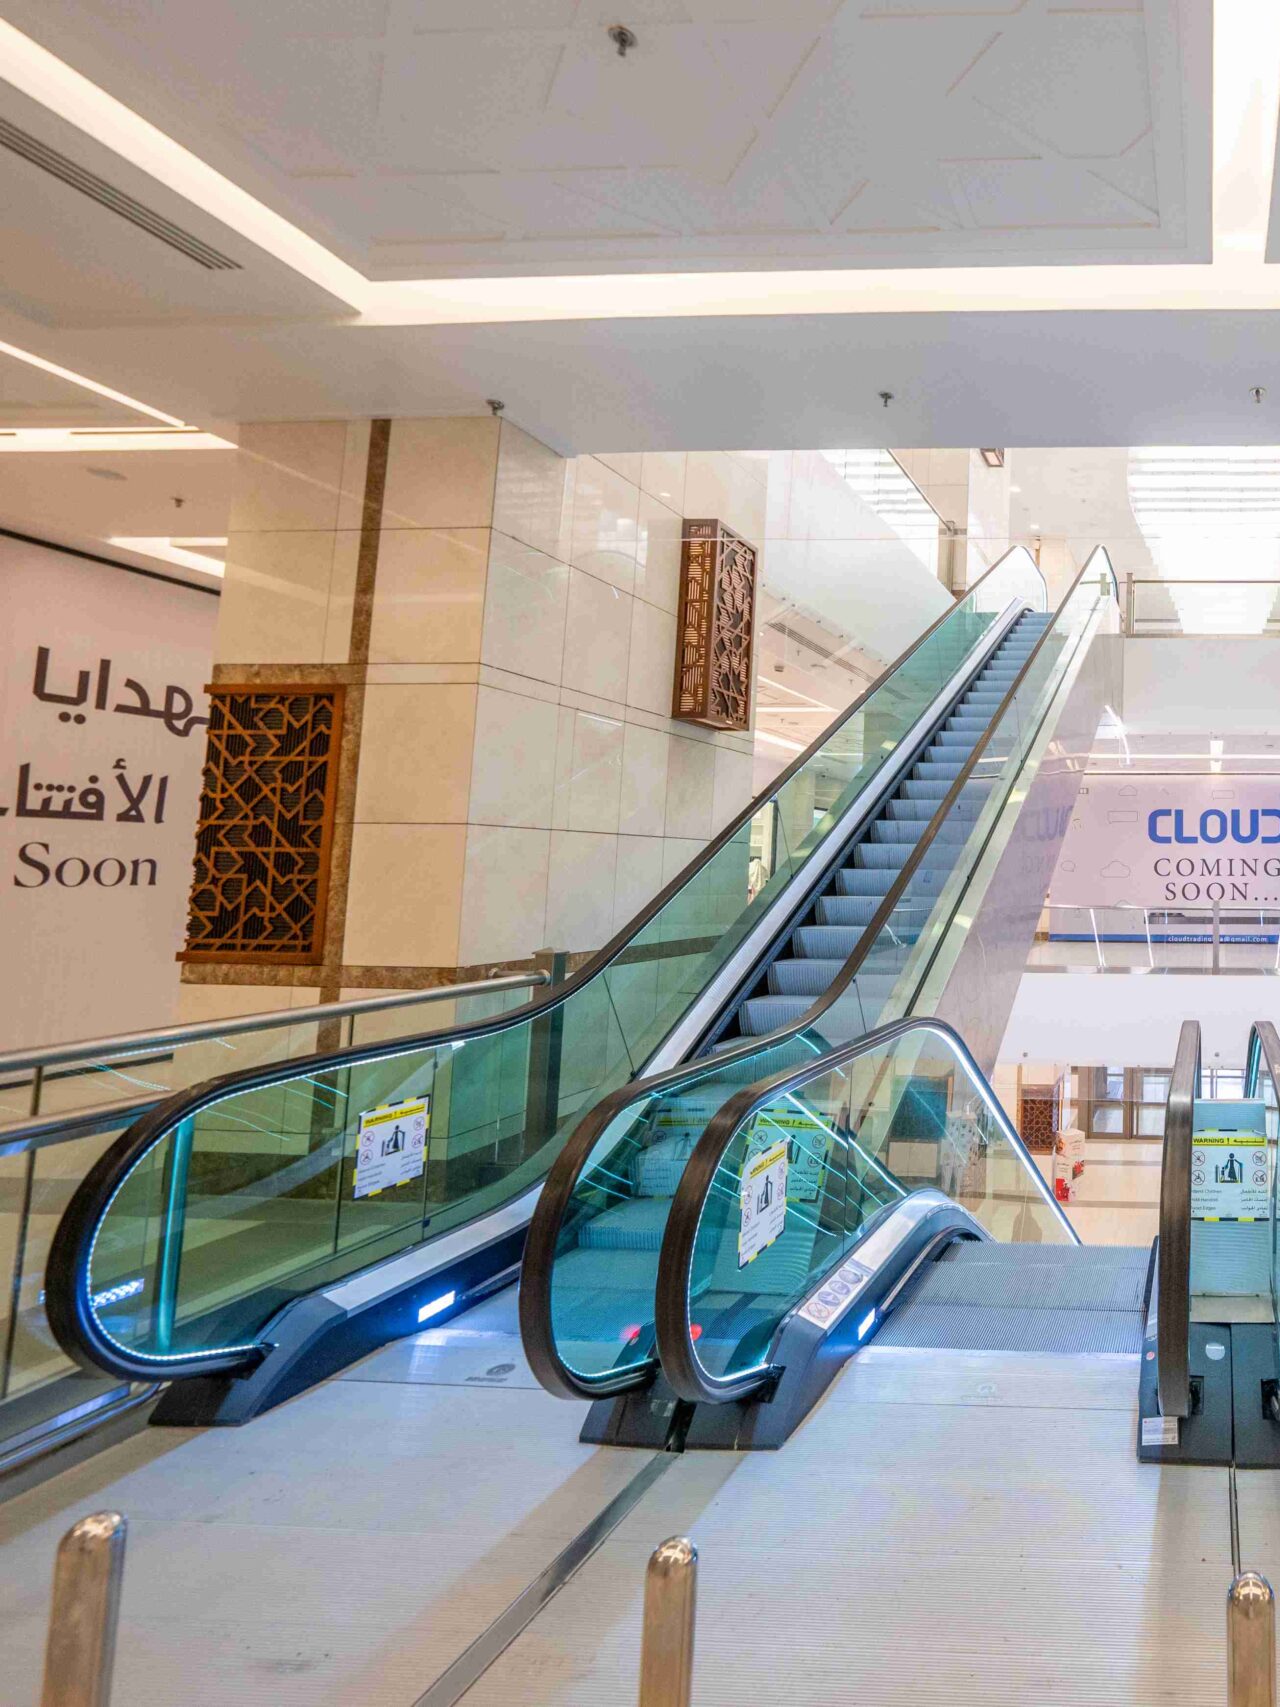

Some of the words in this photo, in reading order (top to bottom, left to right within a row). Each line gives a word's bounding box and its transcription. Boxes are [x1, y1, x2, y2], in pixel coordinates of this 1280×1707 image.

[0, 758, 169, 824] الأفتتا
[14, 841, 158, 888] Soon
[1165, 882, 1278, 901] SOON...
